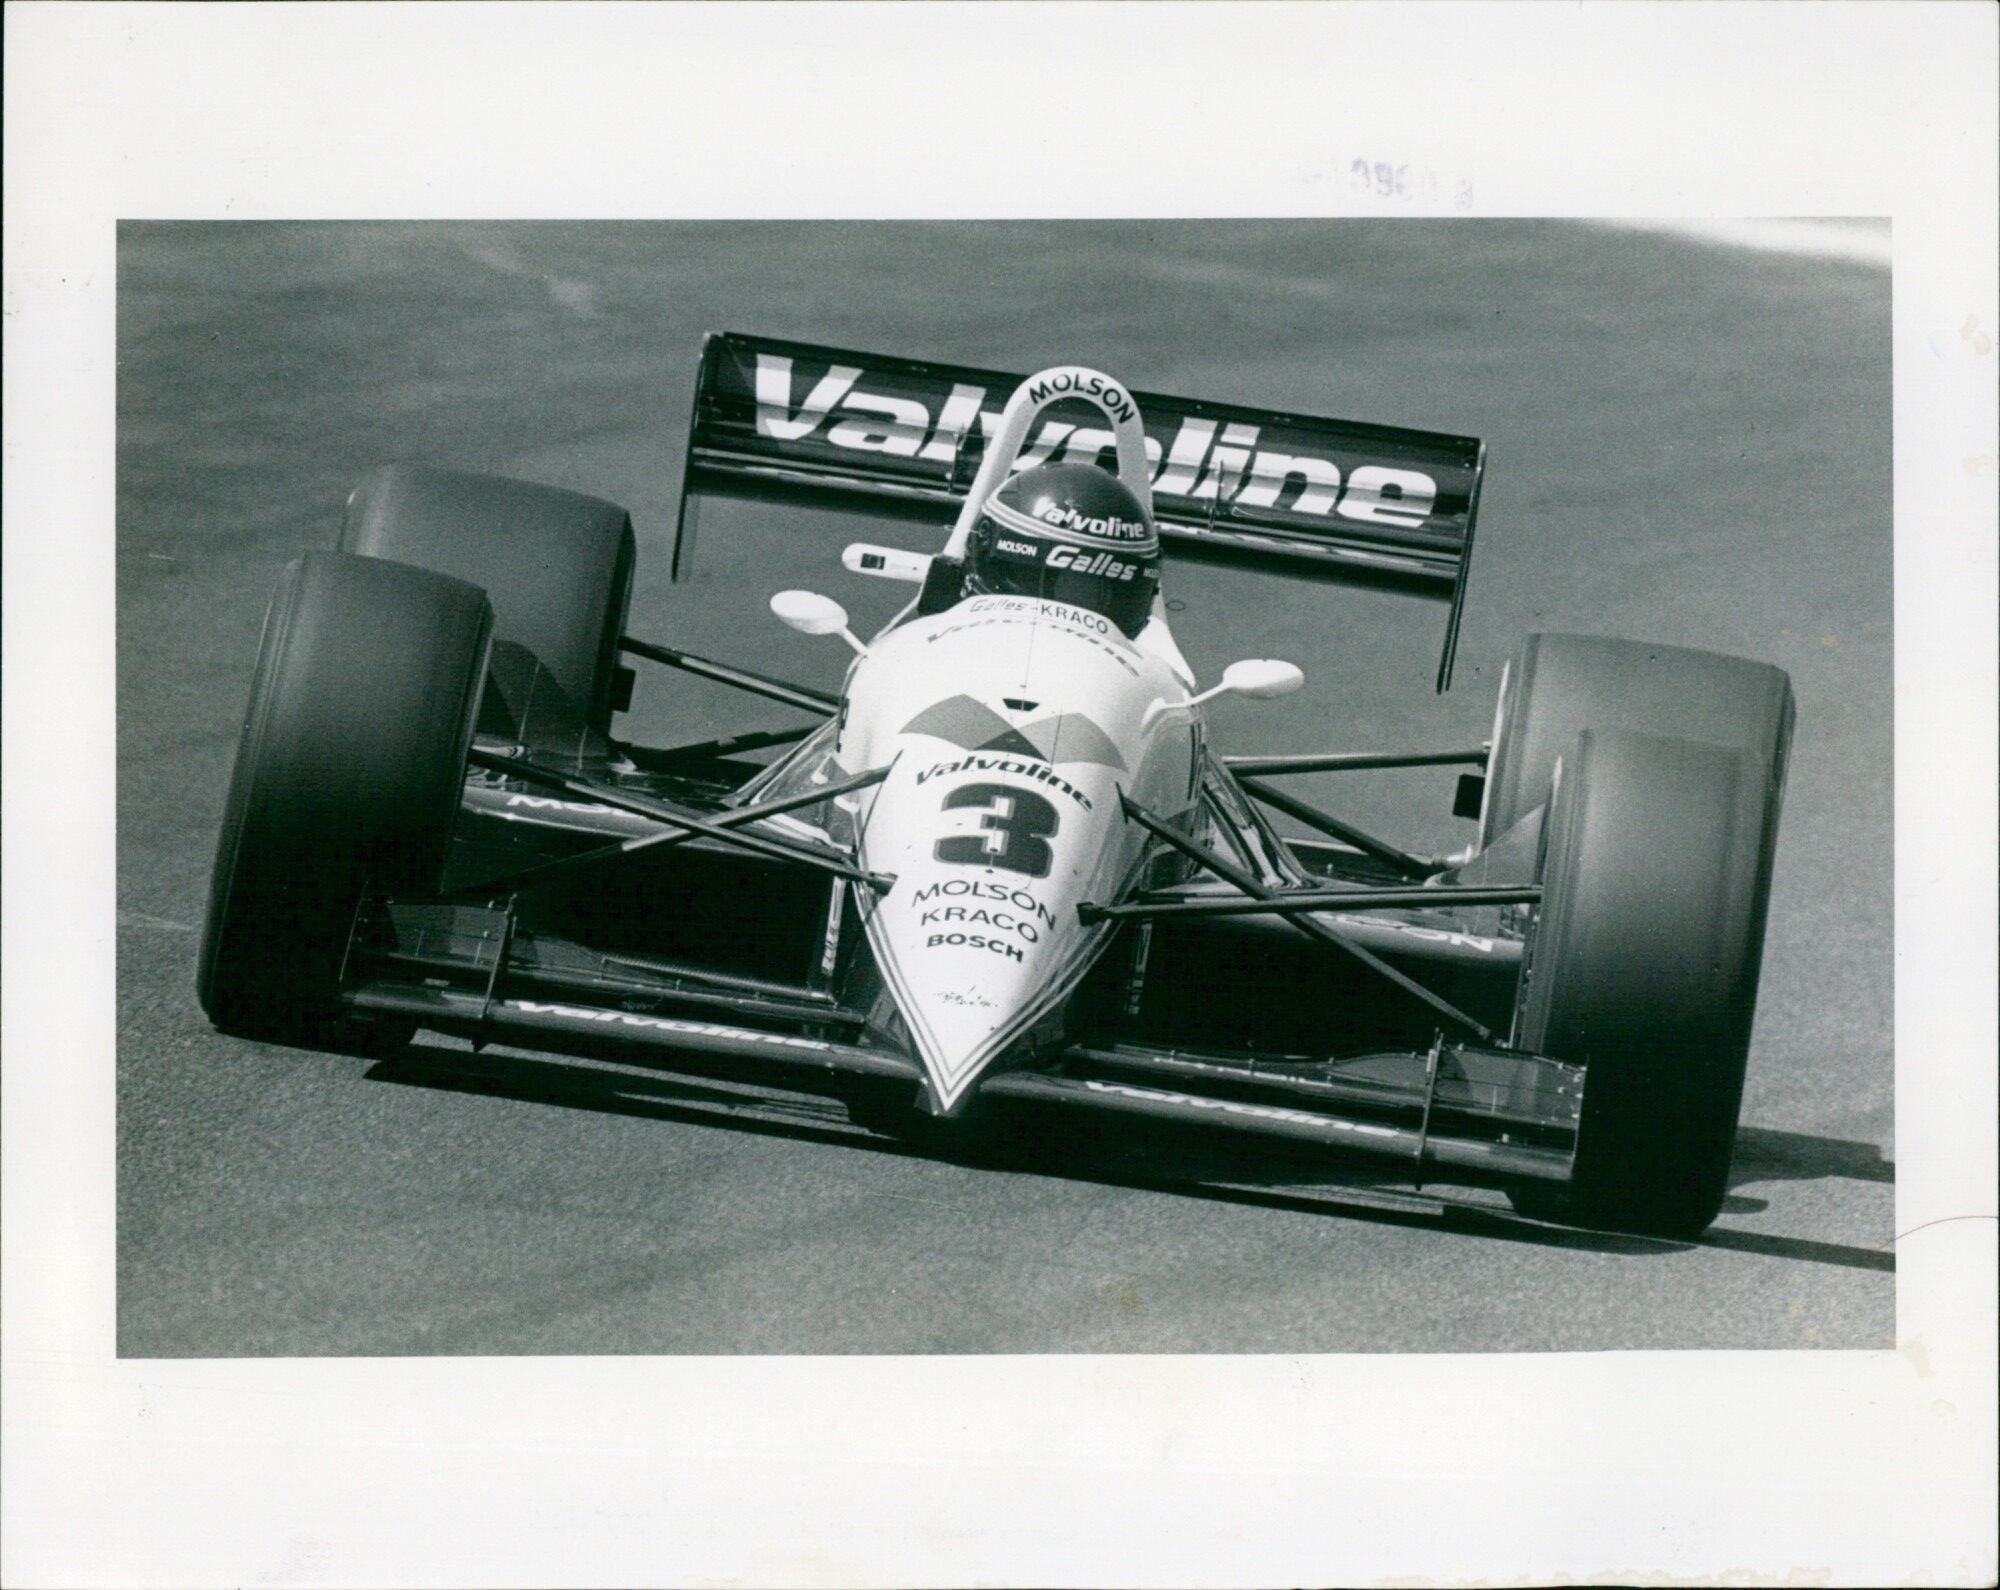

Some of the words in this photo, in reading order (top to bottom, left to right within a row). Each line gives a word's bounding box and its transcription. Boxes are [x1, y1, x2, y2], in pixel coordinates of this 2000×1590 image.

[1028, 373, 1135, 425] MOLSON
[1031, 498, 1146, 538] Valvoline
[996, 540, 1038, 557] MOLSON
[1045, 545, 1138, 581] Galles
[915, 755, 1094, 812] Valvoline
[933, 782, 1061, 879] 3
[911, 879, 1057, 931] MOLSON
[919, 906, 1040, 943] KRACO
[926, 933, 1025, 963] BOSCH
